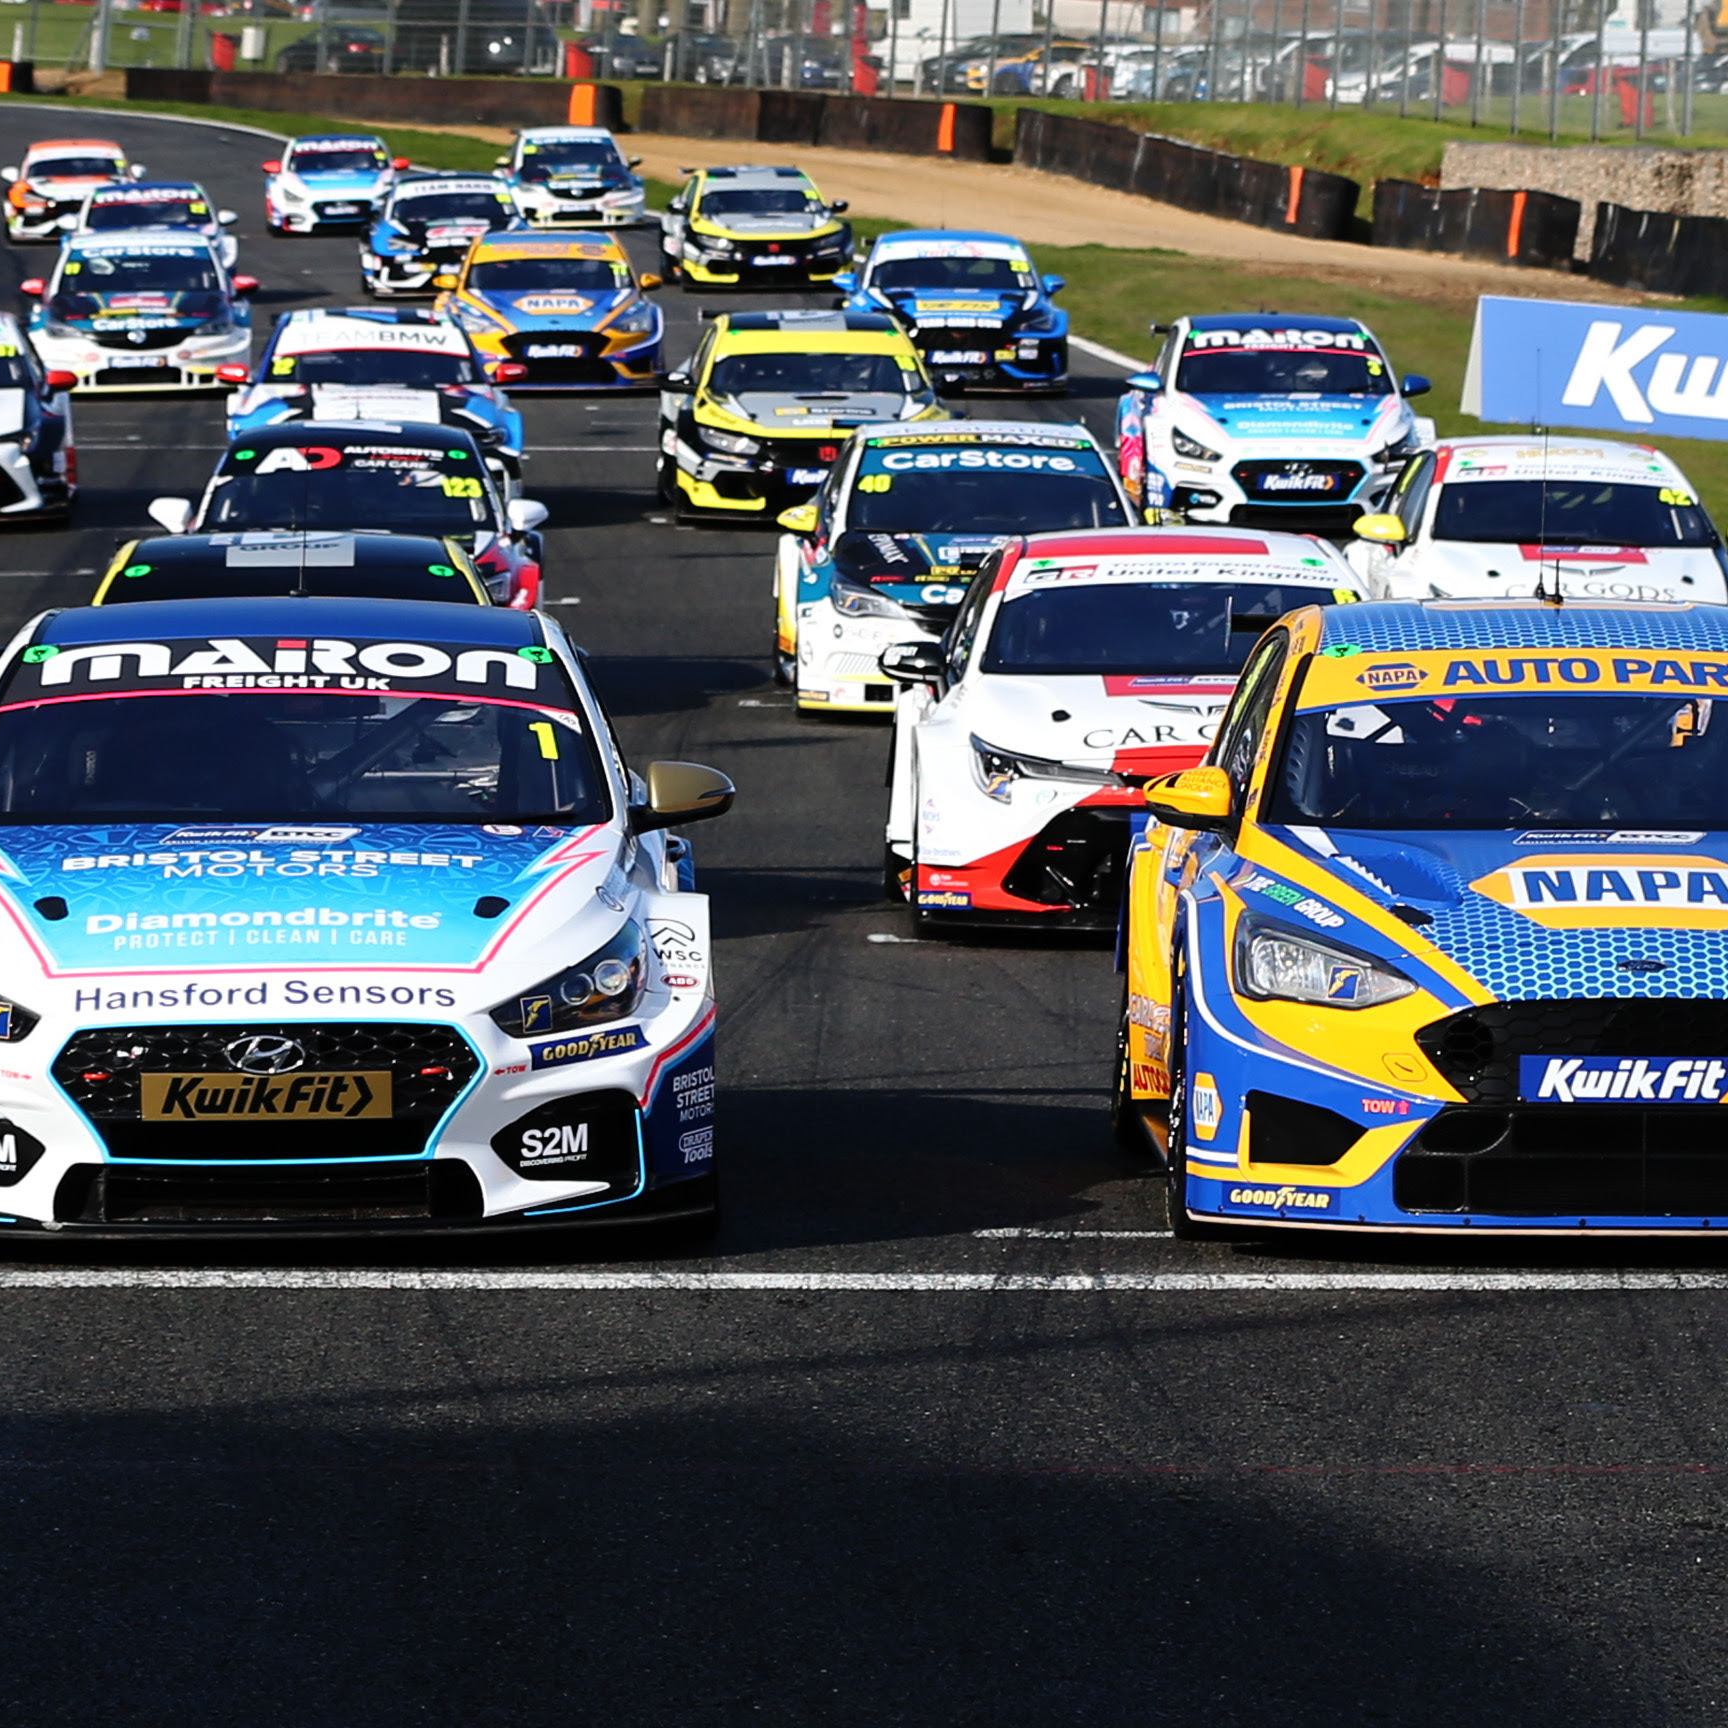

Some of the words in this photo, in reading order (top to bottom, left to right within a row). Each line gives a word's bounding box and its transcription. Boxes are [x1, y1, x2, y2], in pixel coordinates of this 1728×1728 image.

[525, 298, 581, 309] NAPA
[1366, 360, 1382, 376] 3
[881, 449, 1077, 471] CarStore
[440, 477, 483, 499] 123
[857, 473, 892, 493] 40
[1658, 487, 1692, 507] 42
[1106, 567, 1201, 581] United
[1216, 567, 1340, 584] Kingdom
[1366, 669, 1419, 684] NAPA
[1442, 657, 1603, 686] AUTO
[182, 674, 334, 690] FREIGHT
[340, 675, 391, 692] UK
[528, 721, 559, 761] 1
[1082, 722, 1176, 749] CAR
[61, 850, 262, 873] BRISTOL
[286, 848, 483, 869] STREET
[162, 862, 380, 880] MOTORS
[86, 905, 440, 936] Diamondbrite
[1293, 898, 1346, 928] GROUP
[113, 929, 217, 951] PROTECT
[246, 927, 325, 948] CLEAN
[349, 928, 408, 948] CARE
[652, 947, 704, 963] WSC
[74, 978, 272, 1014] Hansford
[283, 979, 457, 1008] Sensors
[0, 1069, 20, 1079] TOW
[505, 1064, 527, 1075] TOW
[672, 1065, 715, 1094] BRISTOL
[675, 1084, 715, 1109] STREET
[1194, 1088, 1215, 1123] NAPA
[1361, 1097, 1397, 1115] TOW
[520, 1122, 589, 1160] S2M
[682, 1144, 714, 1164] Tools
